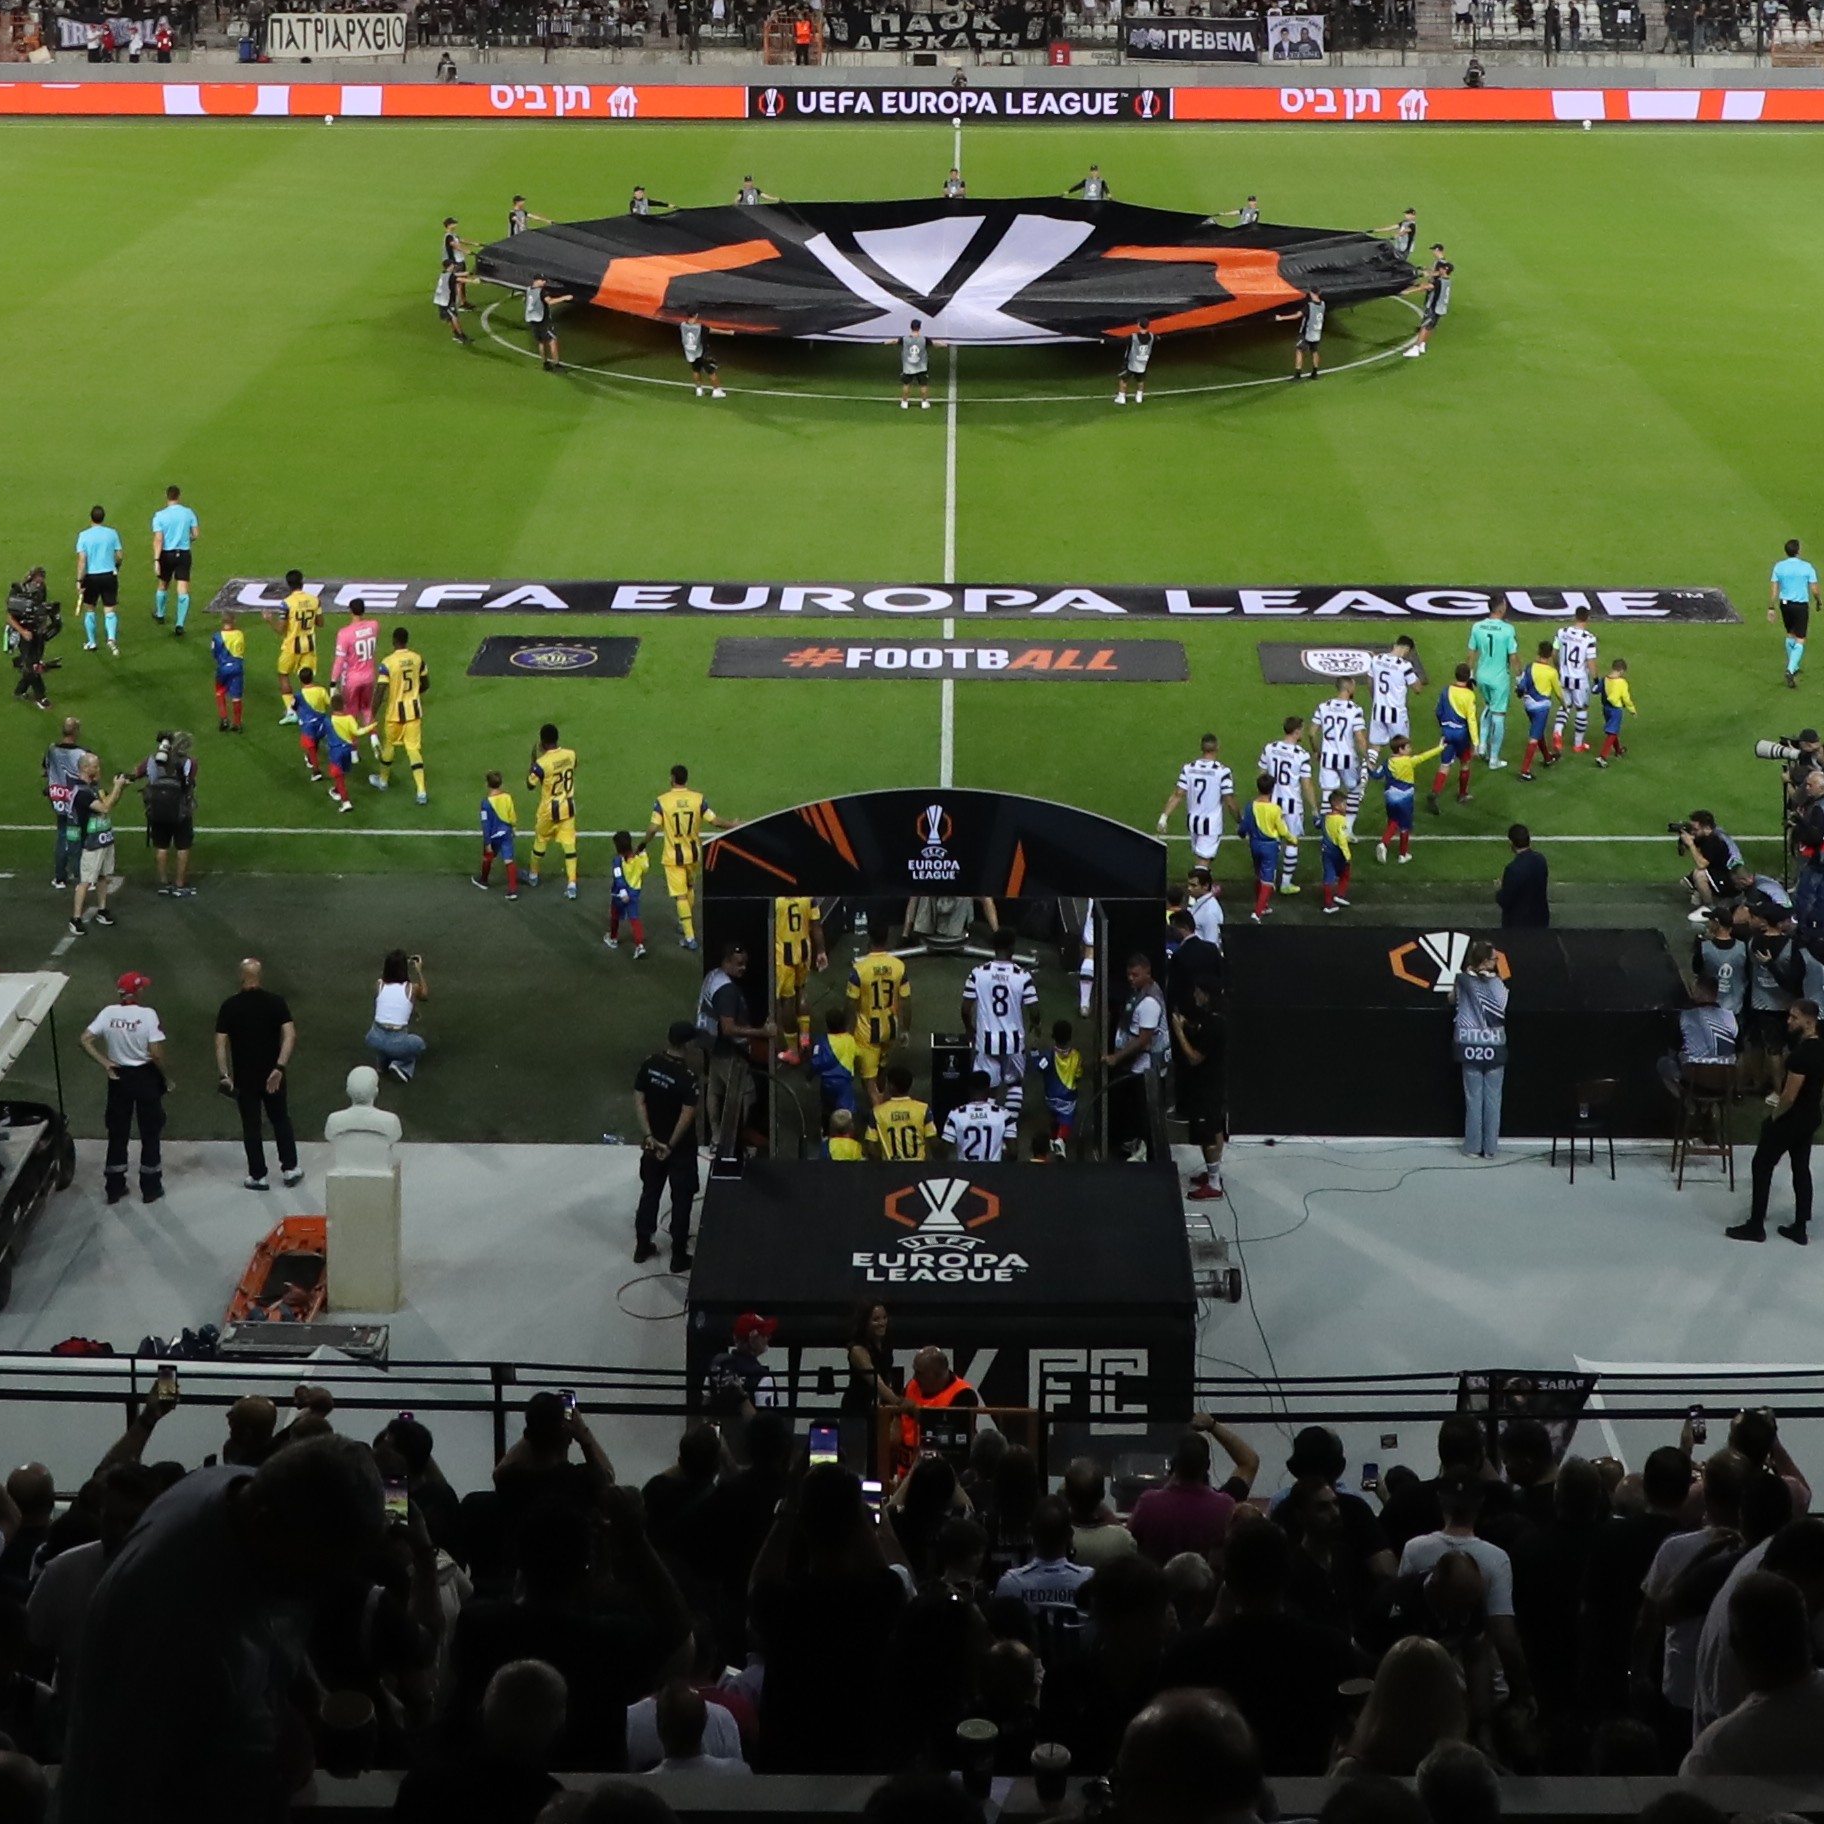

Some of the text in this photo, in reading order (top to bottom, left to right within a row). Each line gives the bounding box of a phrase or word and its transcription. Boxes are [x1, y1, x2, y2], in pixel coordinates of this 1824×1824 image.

[270, 16, 404, 51] ΠΑΤΡΙΑΡΧΕΙΟ
[870, 11, 1001, 34] ΠΑΟΚ
[1167, 29, 1256, 51] ΓΡΕΒΕΝΑ
[491, 84, 591, 117] תן ביס
[796, 91, 874, 114] UEFA
[881, 91, 998, 114] EUROPA
[1280, 88, 1381, 120] תן ביס
[236, 583, 570, 609] UEFA
[610, 584, 1128, 614] EUROPA
[295, 609, 315, 631] 42
[355, 636, 377, 662] 90
[1487, 633, 1493, 658] 1
[1562, 642, 1580, 669] 14
[782, 647, 1121, 672] #FOOTBALL
[403, 669, 413, 694] 5
[1379, 671, 1390, 695] 5
[1323, 715, 1348, 742] 27
[551, 768, 574, 796] 28
[1273, 758, 1292, 786] 16
[1194, 778, 1207, 804] 7
[672, 811, 694, 838] 17
[908, 859, 961, 871] EUROPA
[912, 871, 956, 881] LEAGUE
[787, 903, 801, 932] 6
[870, 979, 894, 1010] 13
[991, 985, 1009, 1017] 8
[1458, 1028, 1501, 1043] PITCH
[1464, 1046, 1496, 1061] 020
[887, 1125, 918, 1161] 10
[964, 1125, 991, 1161] 21
[900, 1236, 978, 1250] UEFA
[851, 1252, 1030, 1268] EUROPA
[1027, 1347, 1149, 1436] FC
